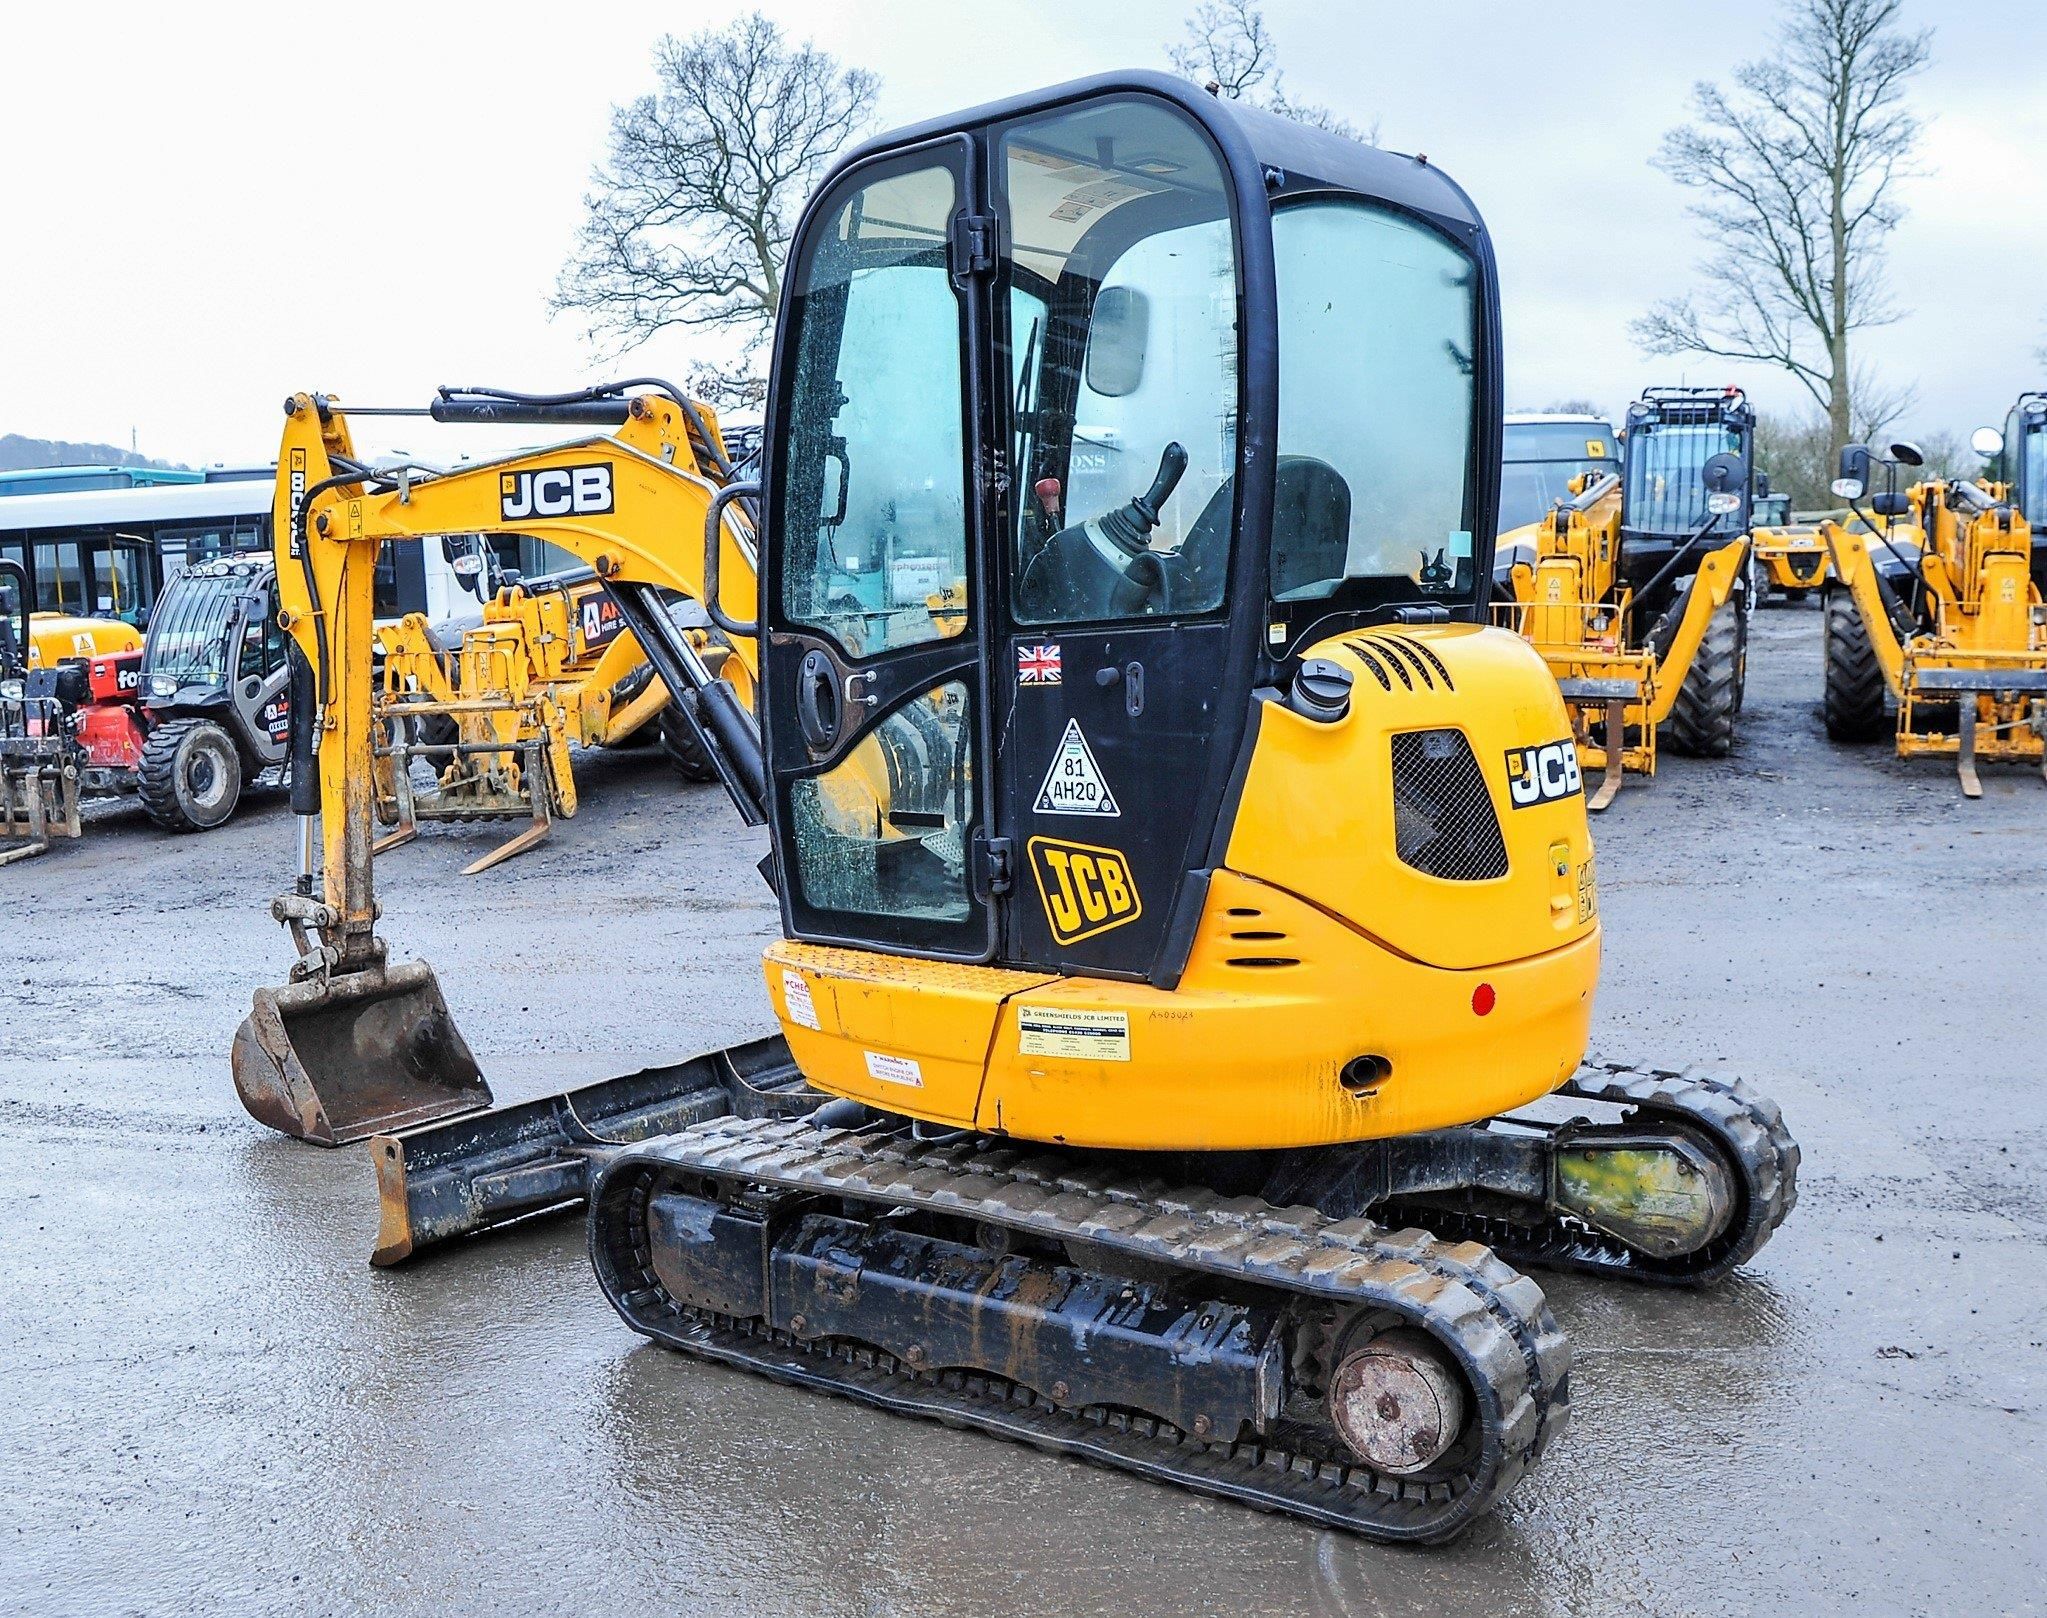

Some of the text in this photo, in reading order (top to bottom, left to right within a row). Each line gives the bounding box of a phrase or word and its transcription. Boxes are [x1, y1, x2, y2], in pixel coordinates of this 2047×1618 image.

[502, 466, 612, 518] JCB
[601, 620, 617, 632] HIRE
[1064, 758, 1085, 777] 81
[1511, 742, 1581, 804] JCB
[1053, 781, 1097, 801] AH2Q
[1043, 848, 1132, 933] JCB
[1033, 1011, 1082, 1020] GREENSHIELDS
